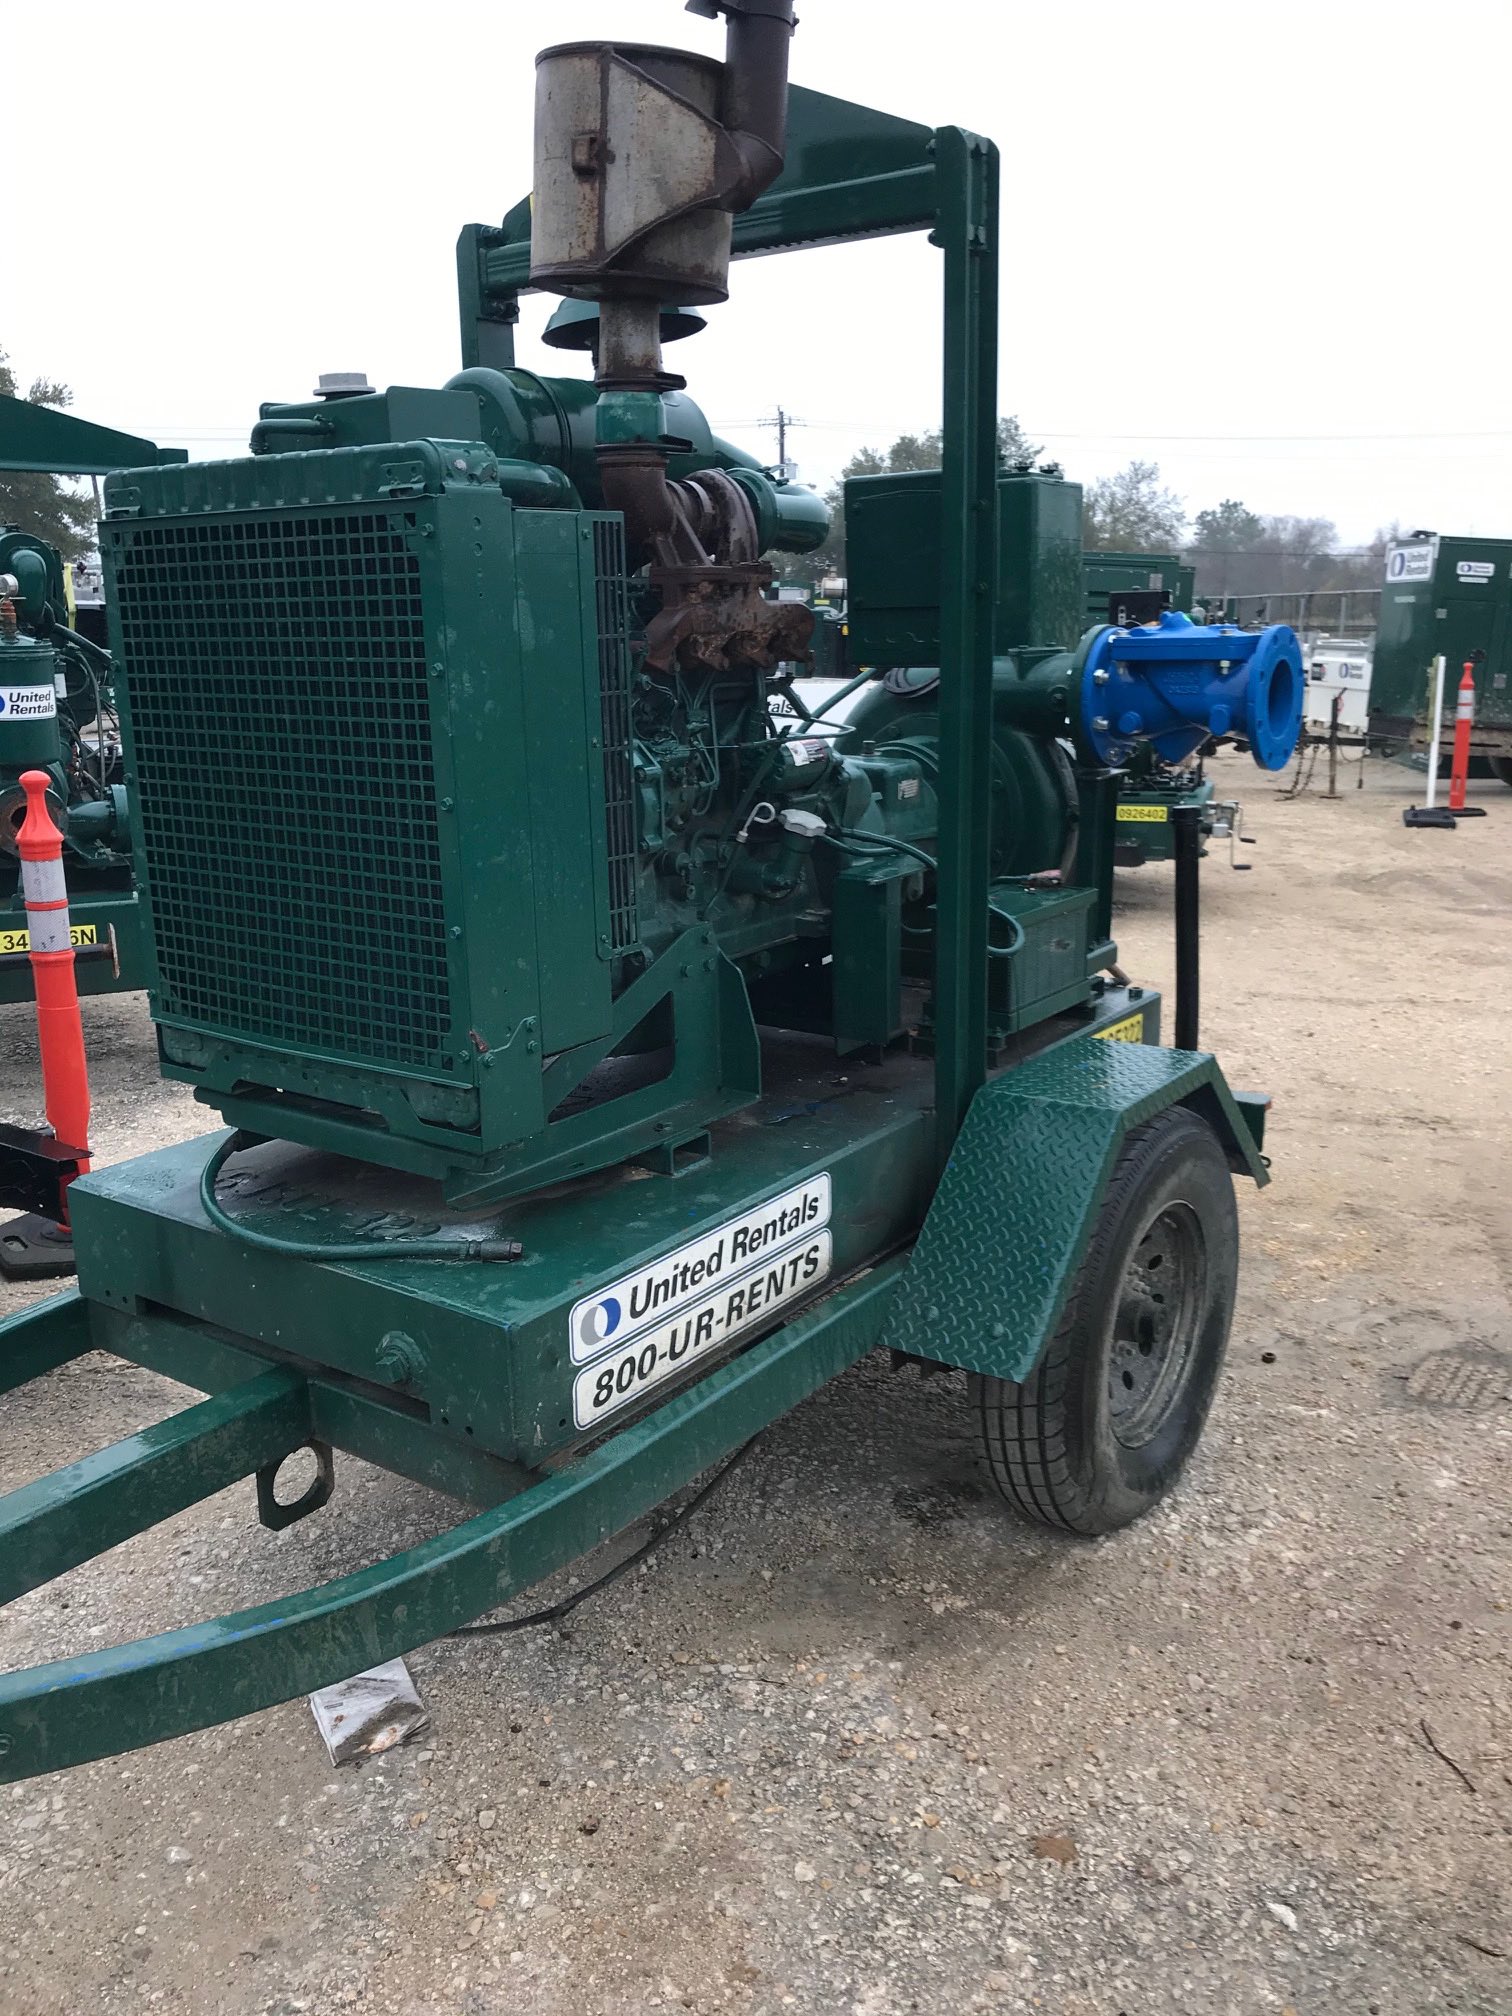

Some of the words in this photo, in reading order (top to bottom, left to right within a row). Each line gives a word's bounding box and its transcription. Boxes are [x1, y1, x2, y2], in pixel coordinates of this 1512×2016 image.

[9, 690, 51, 703] United
[10, 702, 54, 715] Rentals
[629, 1239, 724, 1320] United
[730, 1192, 819, 1265] Rentals
[592, 1244, 820, 1409] 800-UR-RENTS
